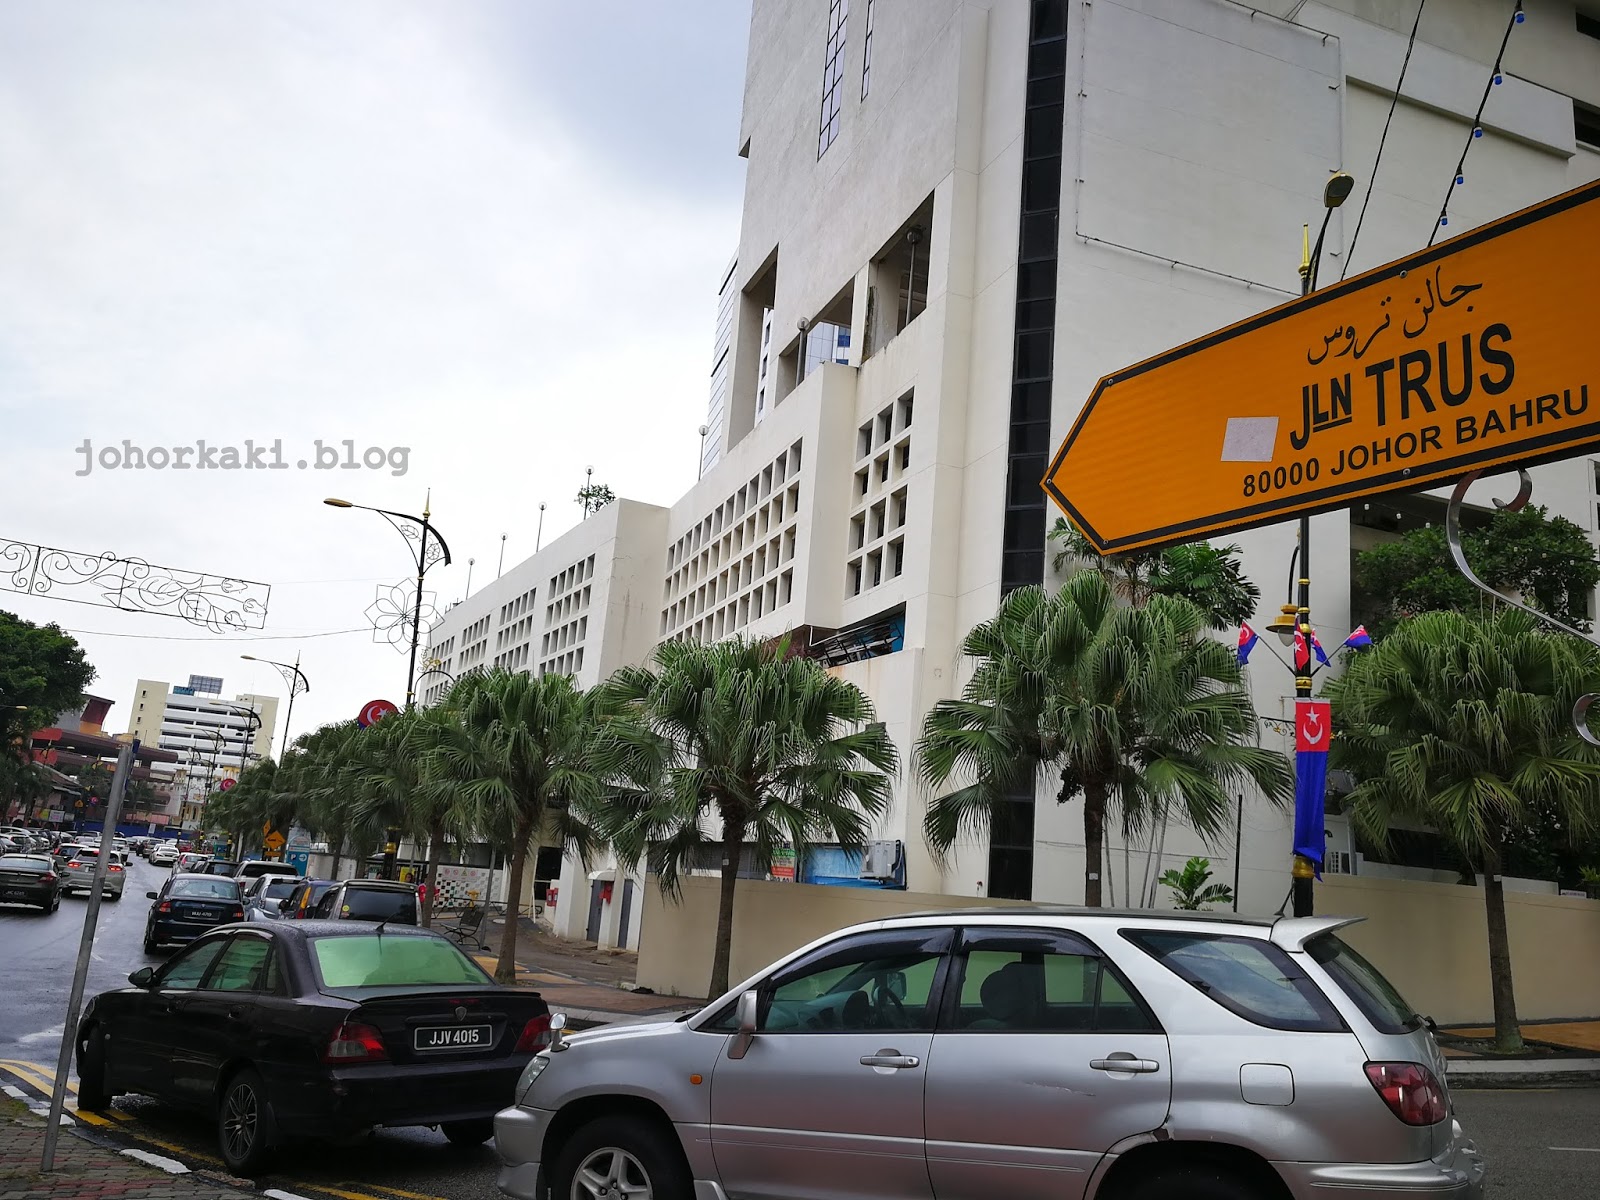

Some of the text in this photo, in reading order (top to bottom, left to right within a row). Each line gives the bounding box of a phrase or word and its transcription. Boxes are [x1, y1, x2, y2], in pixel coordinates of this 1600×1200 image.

[1242, 384, 1589, 498] 80000 JOHOR BAHRU
[1289, 322, 1516, 451] JLN TRUS
[429, 1029, 480, 1045] JJV 4015
